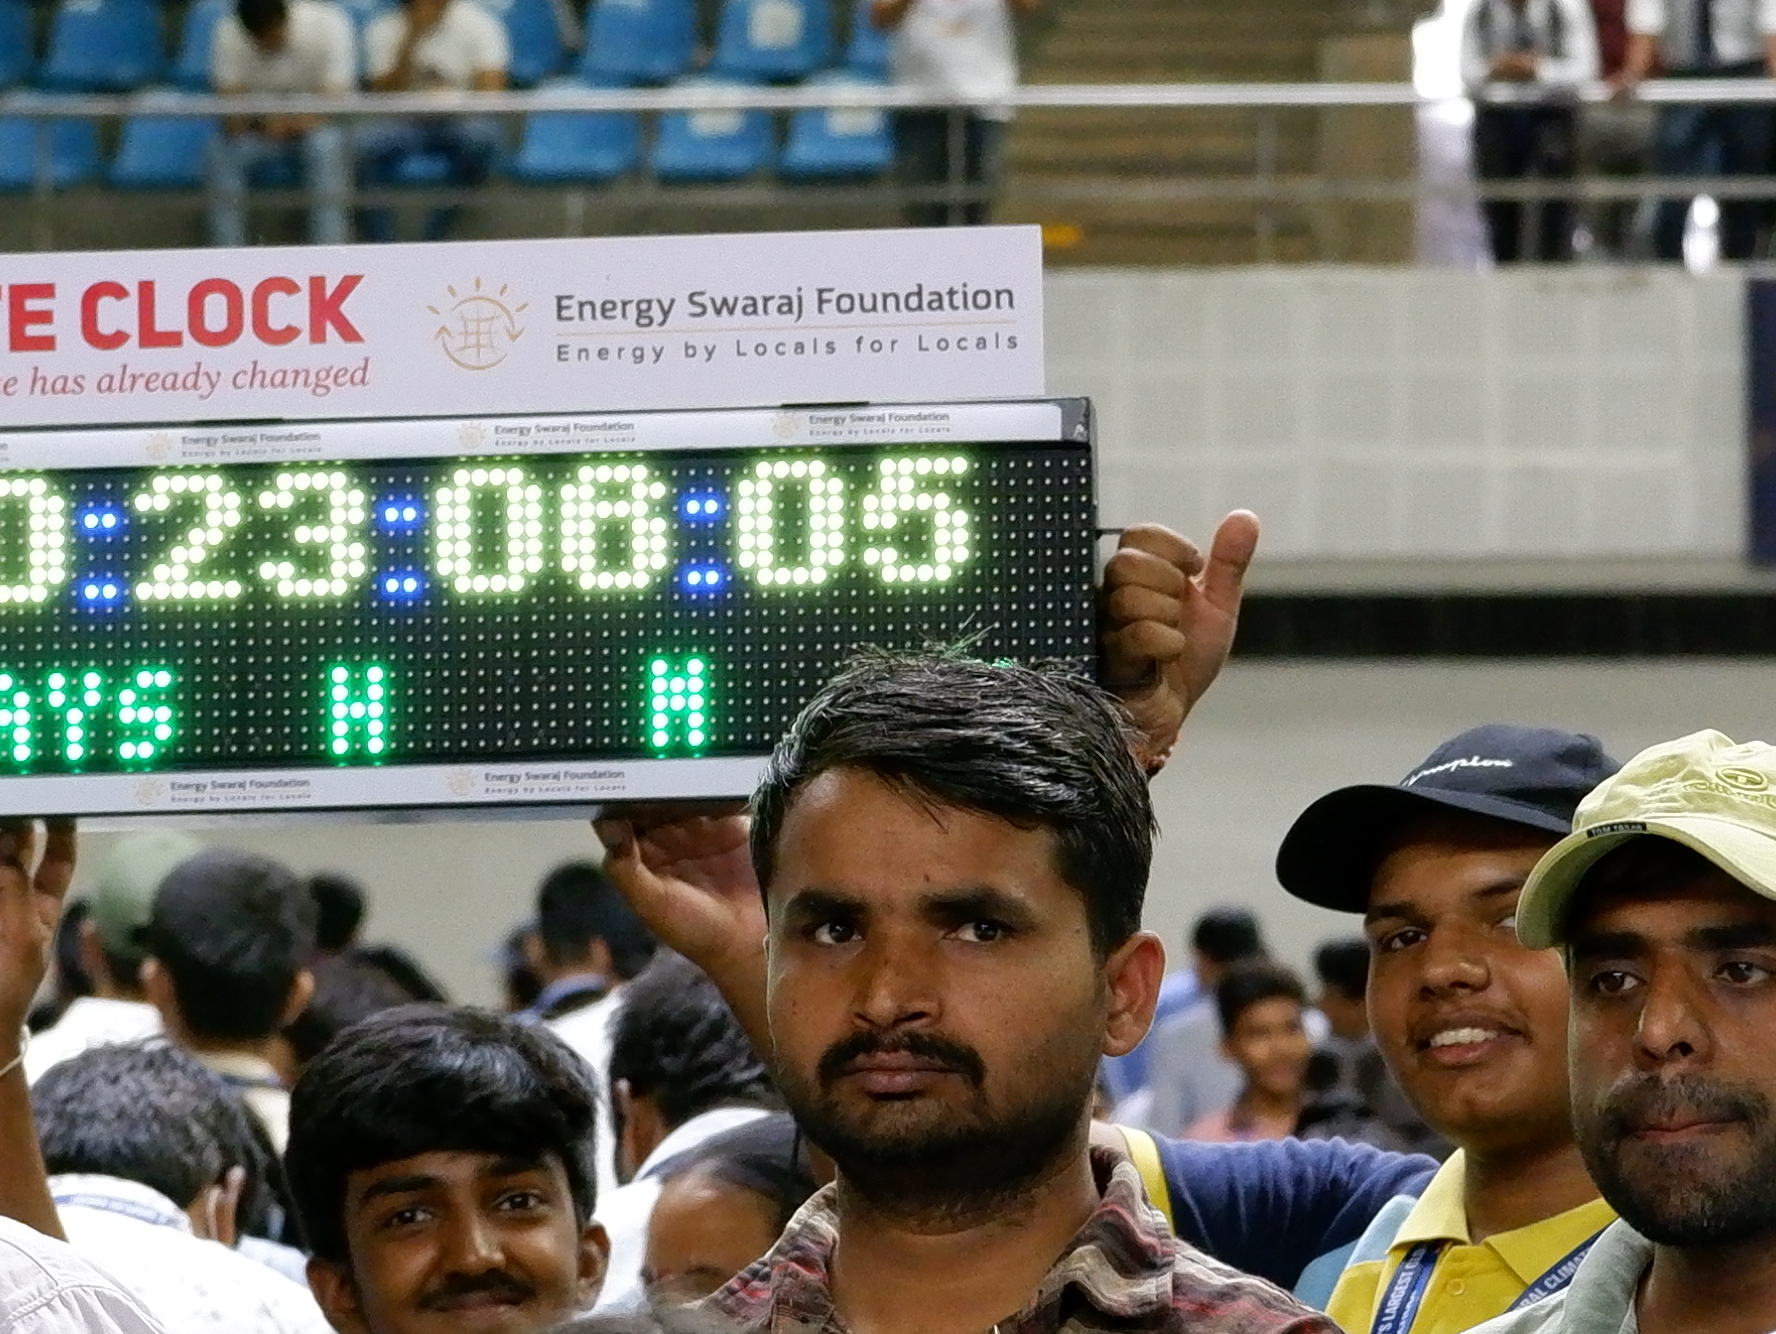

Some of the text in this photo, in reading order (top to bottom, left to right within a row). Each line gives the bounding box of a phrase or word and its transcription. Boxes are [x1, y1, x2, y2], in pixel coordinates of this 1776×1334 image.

[81, 274, 365, 351] CLOCK
[555, 283, 1015, 327] Energy Swaraj Foundation
[557, 331, 1020, 365] Energy by Locals for Locals
[30, 366, 86, 397] has
[96, 363, 222, 400] already
[232, 358, 371, 398] changed
[330, 666, 385, 756] H
[1401, 755, 1514, 787] hampion
